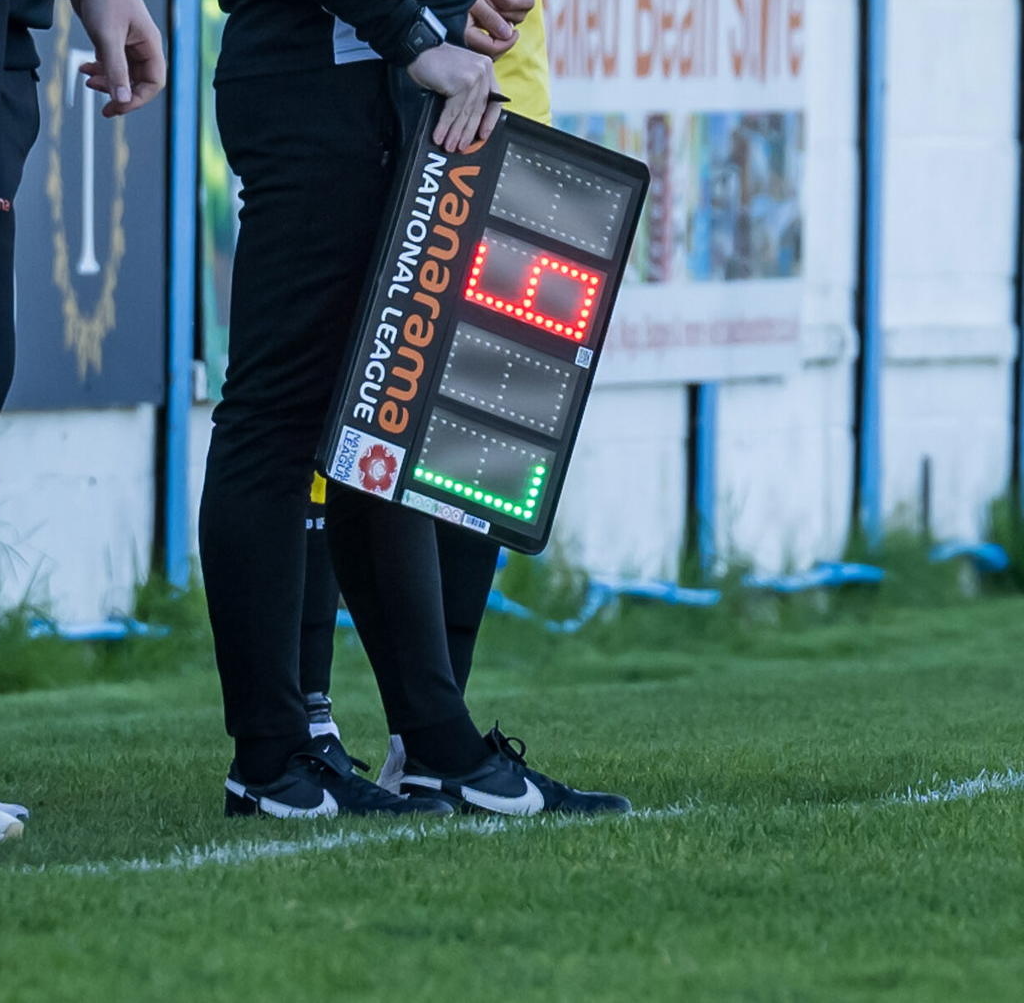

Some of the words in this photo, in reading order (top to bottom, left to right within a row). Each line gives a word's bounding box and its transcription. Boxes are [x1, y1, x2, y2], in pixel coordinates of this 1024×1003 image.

[386, 151, 448, 299] NATIONAL
[352, 308, 404, 424] LEAGUE
[378, 165, 481, 435] vanarama
[332, 429, 355, 482] LEAGUE
